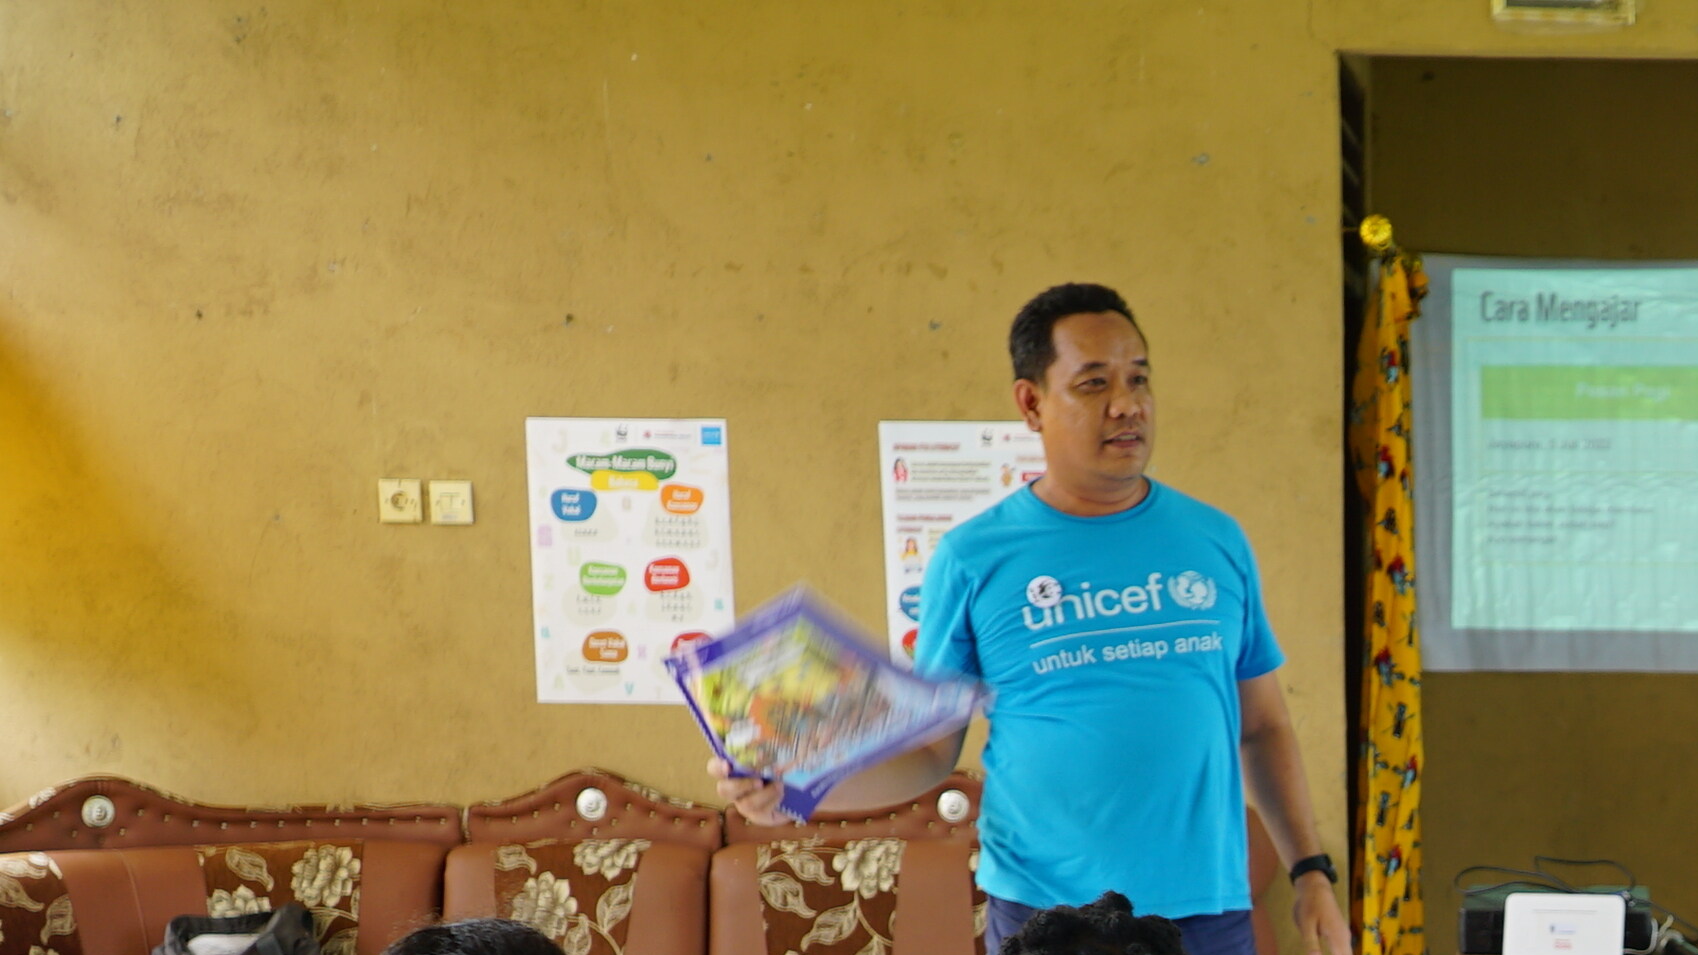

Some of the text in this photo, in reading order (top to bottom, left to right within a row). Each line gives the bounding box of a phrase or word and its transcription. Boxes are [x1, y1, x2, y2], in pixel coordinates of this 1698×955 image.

[1480, 290, 1642, 330] Cara Mengajar
[1021, 572, 1164, 630] unicef
[1031, 631, 1224, 675] untuk setiap anak
